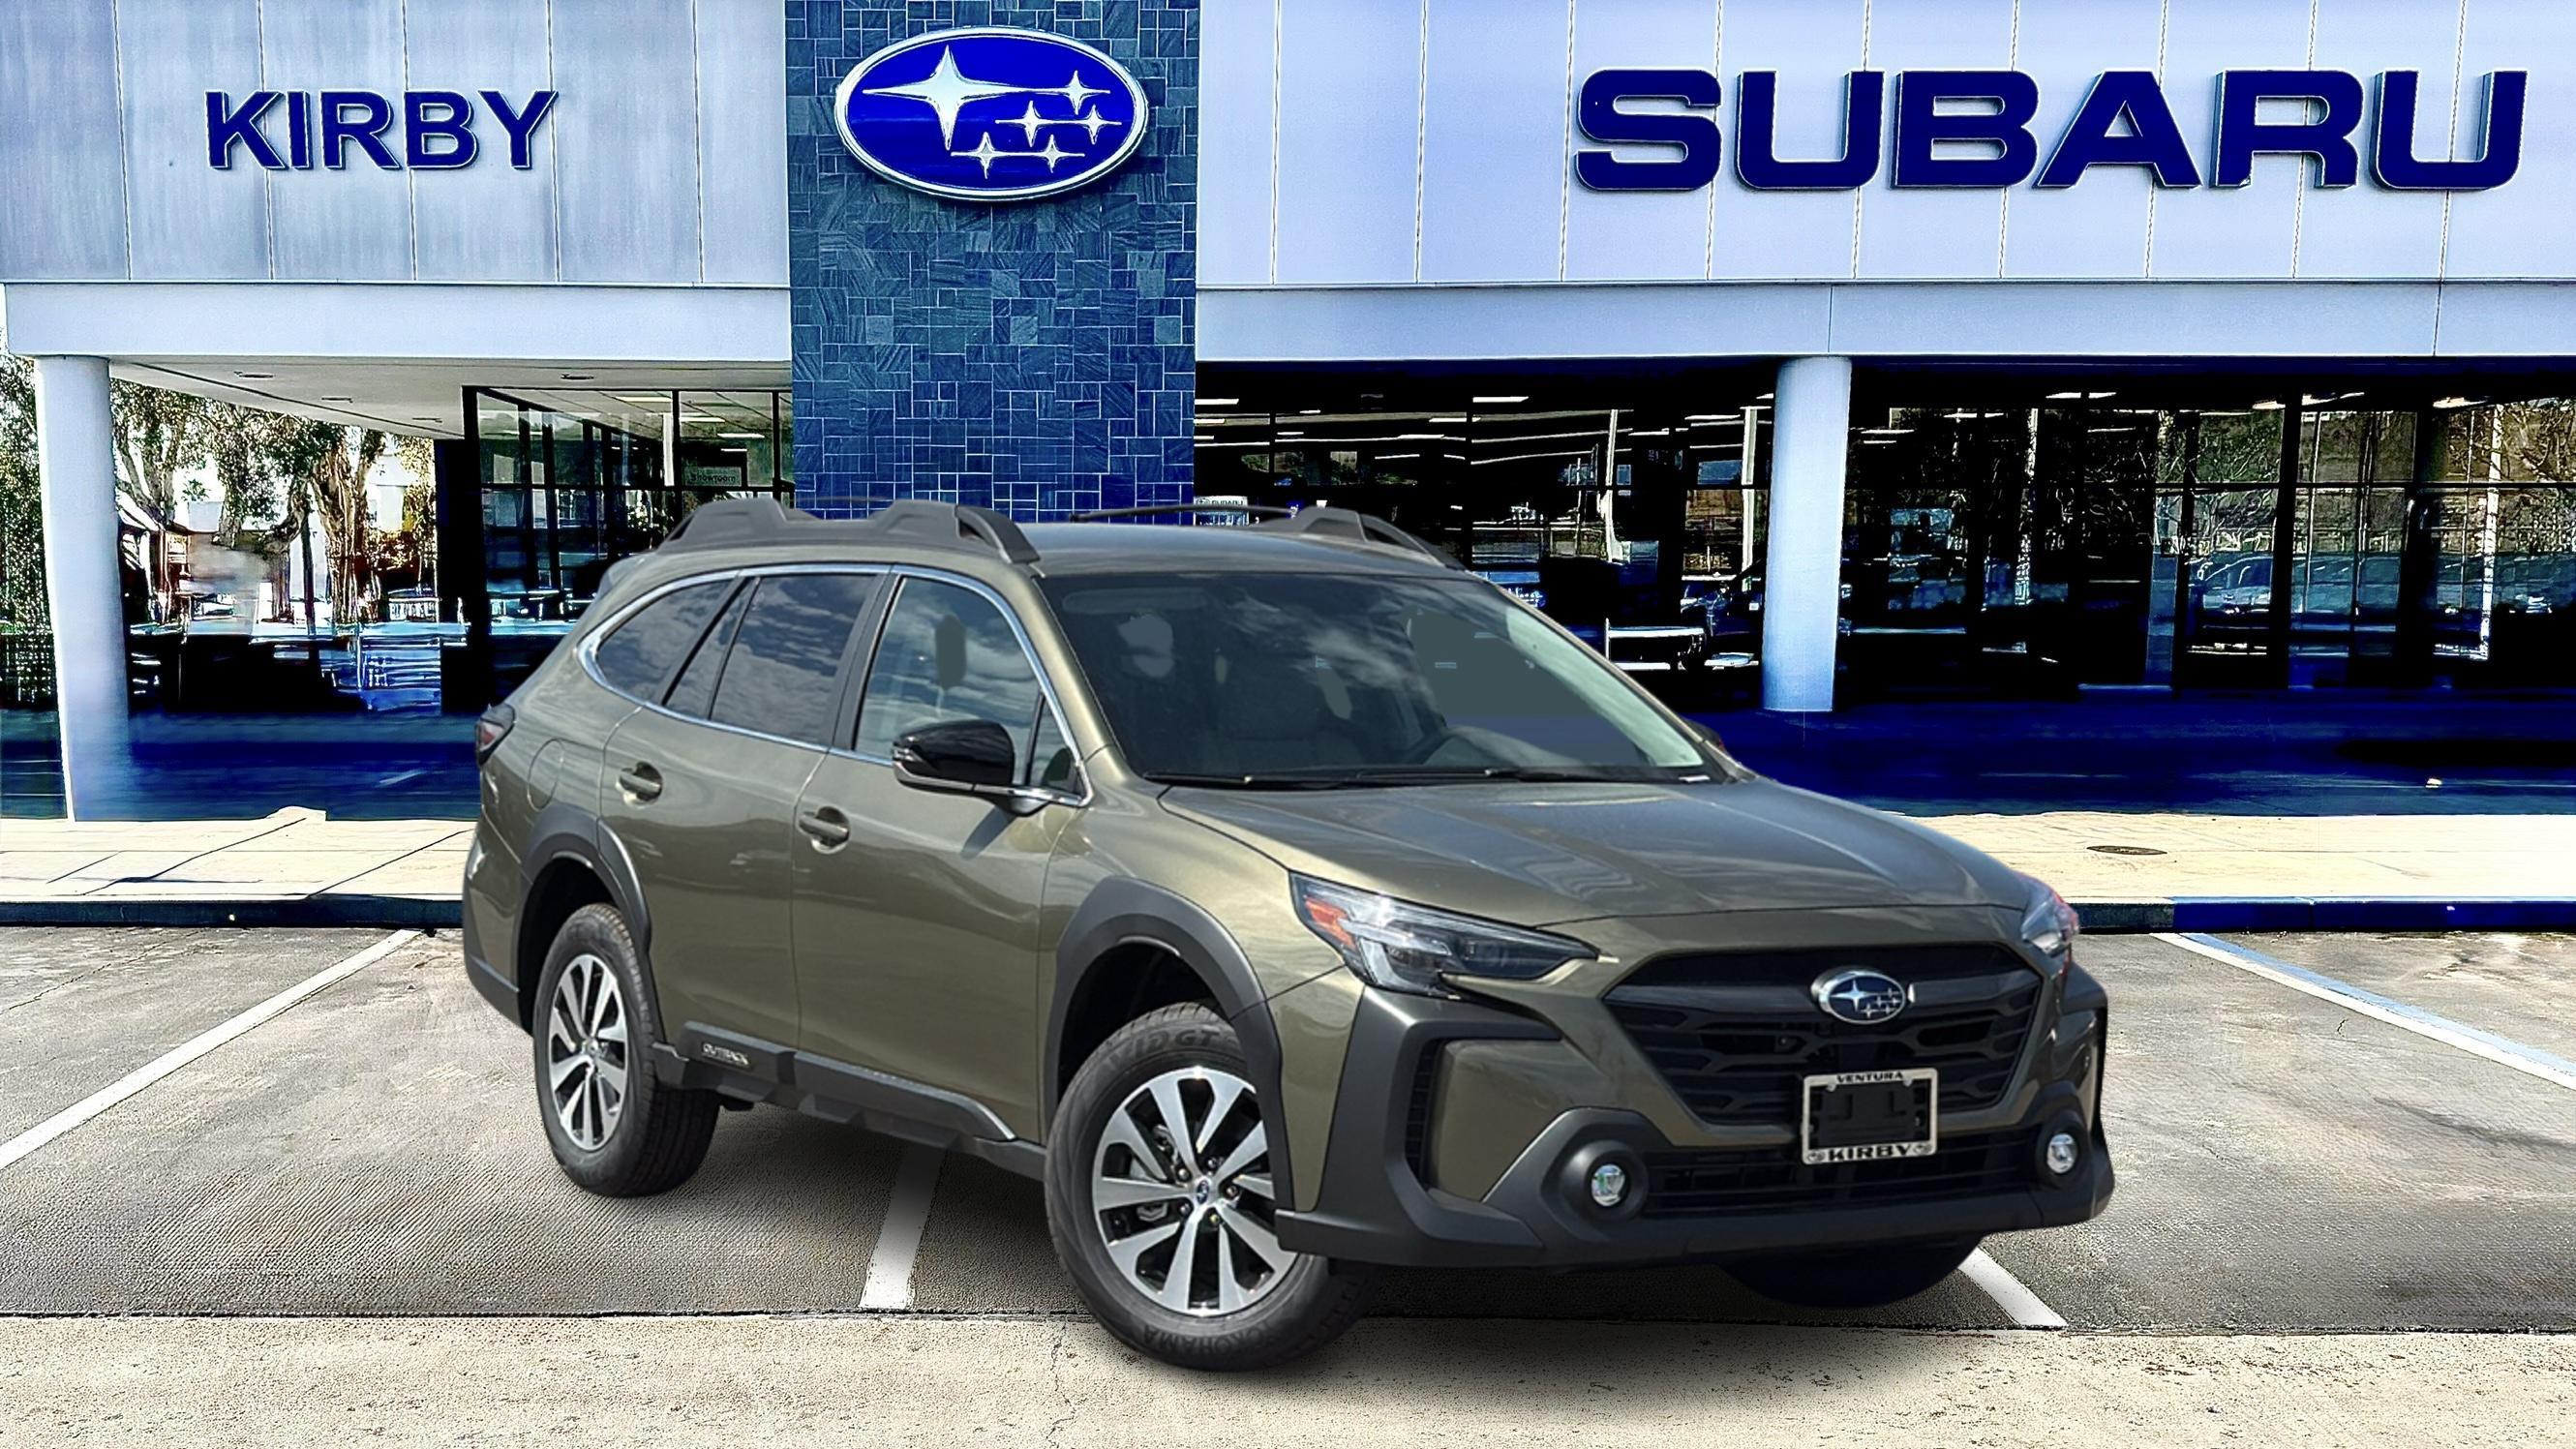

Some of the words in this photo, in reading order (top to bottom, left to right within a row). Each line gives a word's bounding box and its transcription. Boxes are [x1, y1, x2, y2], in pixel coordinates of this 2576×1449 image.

[204, 90, 559, 169] KIRBY
[1574, 69, 2528, 193] SUBARU
[1837, 1072, 1903, 1083] VENTURA
[1829, 1145, 1912, 1162] KIRBY
